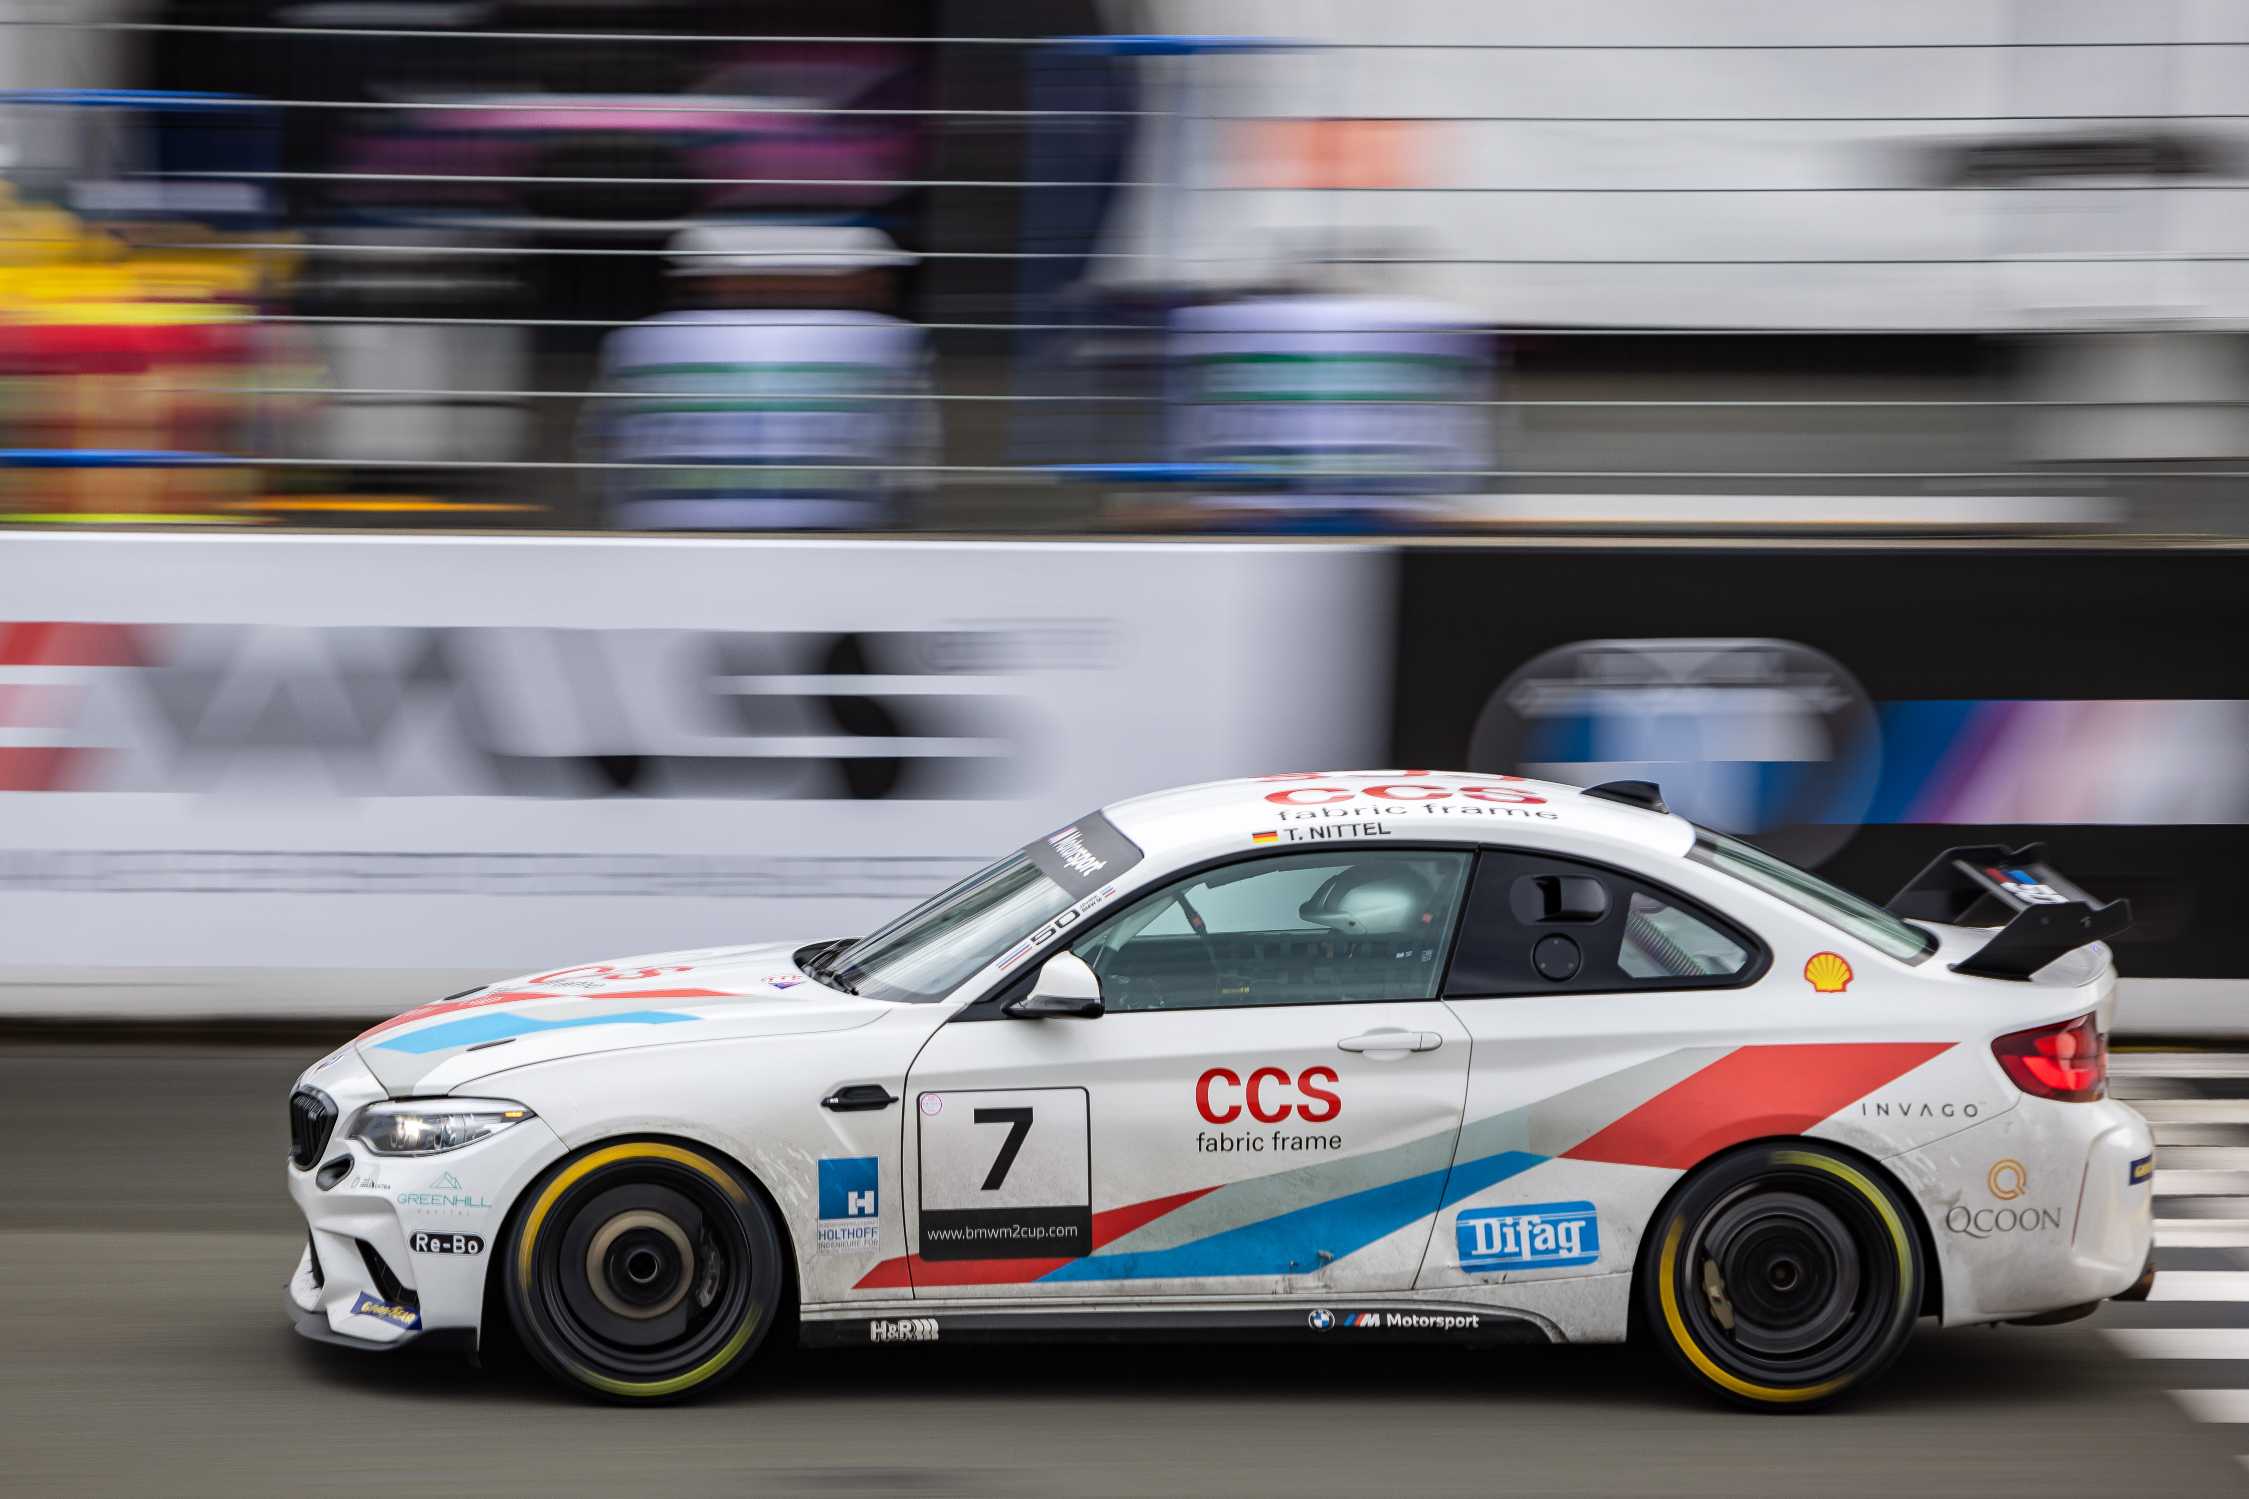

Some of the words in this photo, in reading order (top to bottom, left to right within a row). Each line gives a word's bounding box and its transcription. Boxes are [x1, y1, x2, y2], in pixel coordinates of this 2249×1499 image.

[1264, 785, 1549, 805] CCS
[1278, 804, 1408, 821] fabric
[1424, 803, 1559, 820] frame
[1284, 828, 1304, 842] T.
[1310, 822, 1392, 840] NITTEL
[1030, 909, 1081, 946] 50
[1196, 1066, 1342, 1124] CCS
[1862, 1103, 1978, 1118] INVAGO
[974, 1107, 1034, 1191] 7
[1197, 1132, 1264, 1152] fabric
[1272, 1131, 1342, 1151] frame
[397, 1193, 492, 1208] GREENHILL
[848, 1190, 875, 1216] H
[927, 1224, 1078, 1241] www.bmwm2cup.com
[1946, 1206, 2061, 1239] QCOON
[415, 1233, 478, 1254] Re-Bo
[818, 1226, 880, 1241] HOLTHOFF
[1470, 1215, 1586, 1260] Difag
[1386, 1313, 1480, 1330] Motorsport
